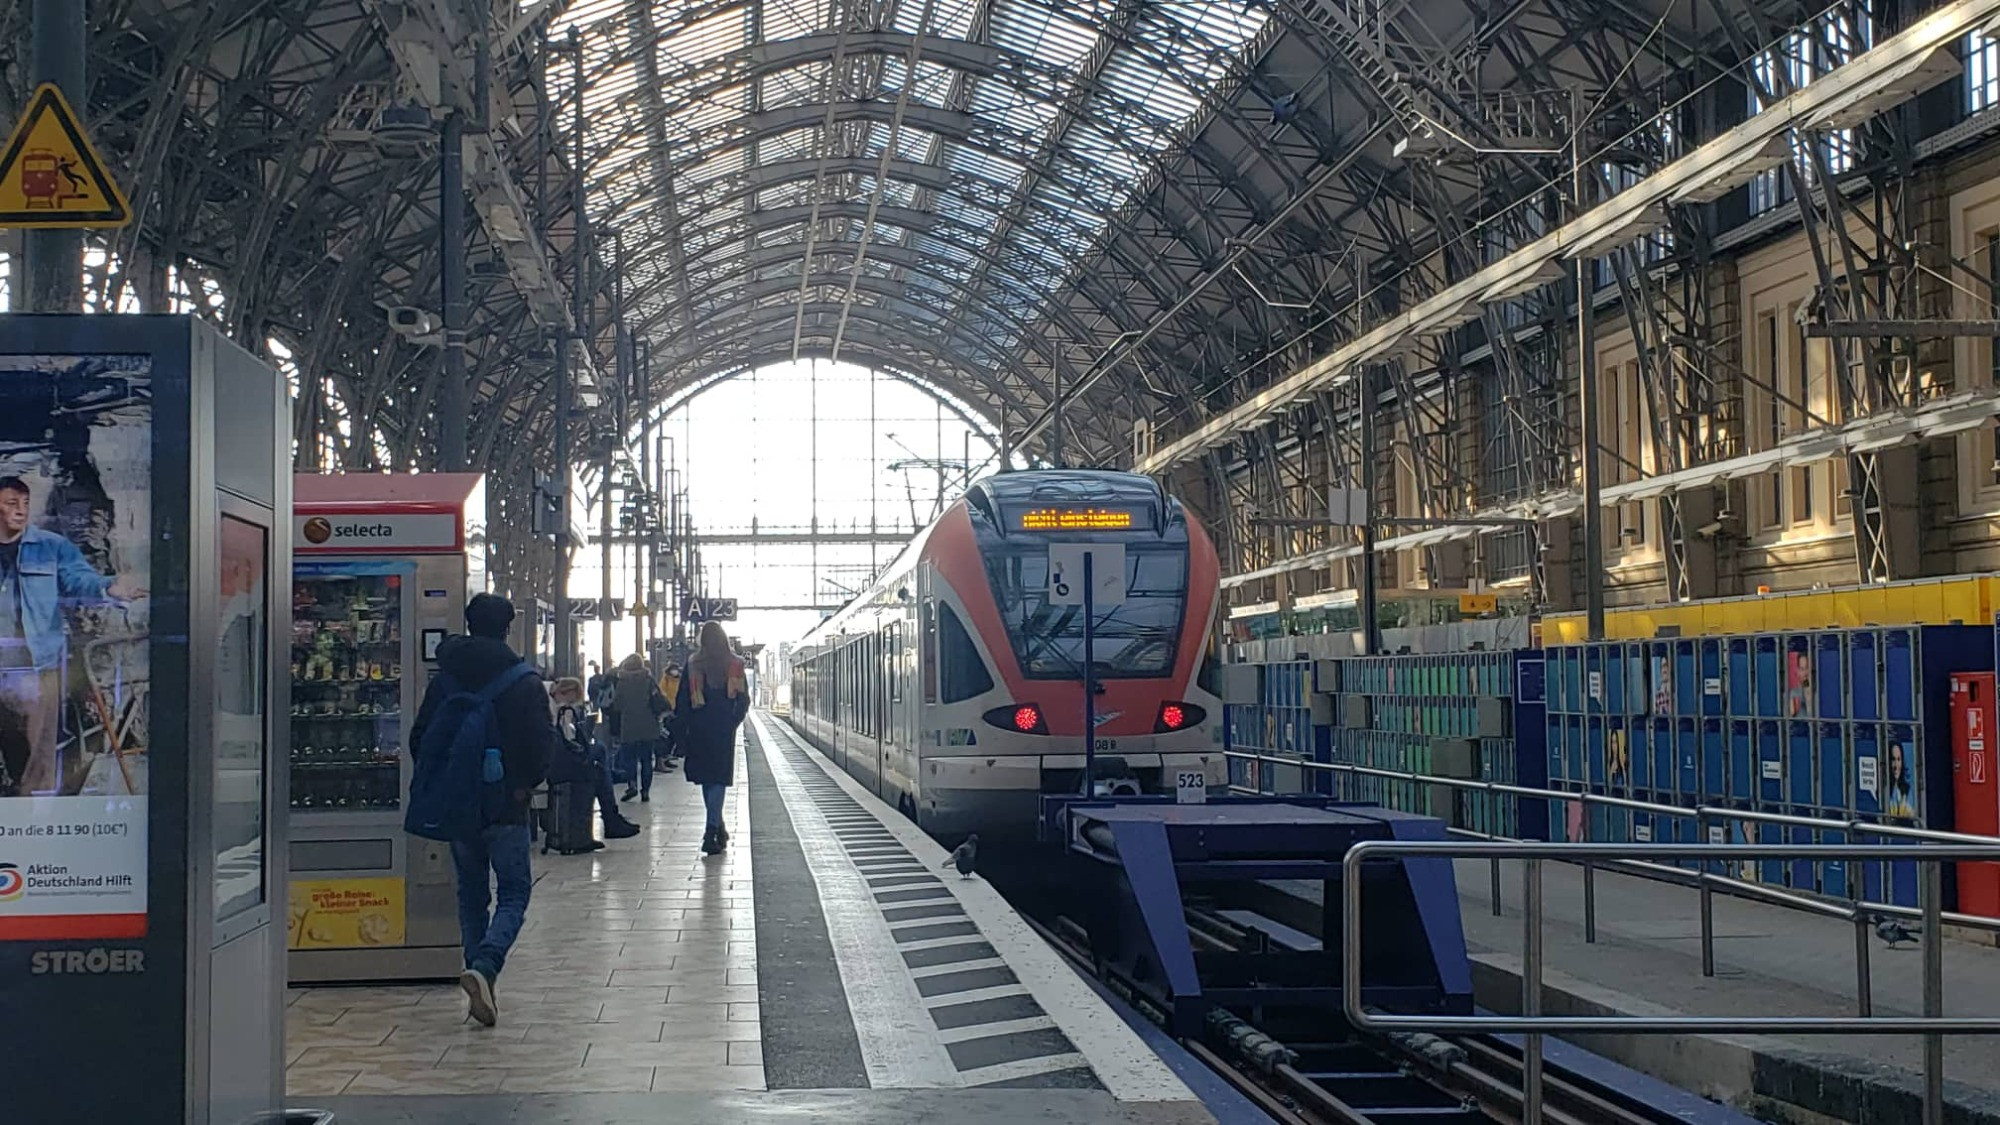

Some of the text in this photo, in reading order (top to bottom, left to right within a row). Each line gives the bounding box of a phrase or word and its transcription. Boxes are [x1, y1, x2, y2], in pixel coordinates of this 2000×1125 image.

[334, 524, 392, 537] selecta
[570, 600, 595, 617] 22
[688, 600, 735, 617] A 23
[1178, 773, 1204, 788] 523
[8, 826, 23, 836] an
[25, 825, 44, 836] die
[46, 825, 54, 835] 8
[57, 825, 72, 835] 11
[74, 825, 90, 835] 90
[27, 864, 68, 875] Aktion
[28, 874, 133, 888] Deutschland Hilft
[31, 948, 145, 974] STRÖER
